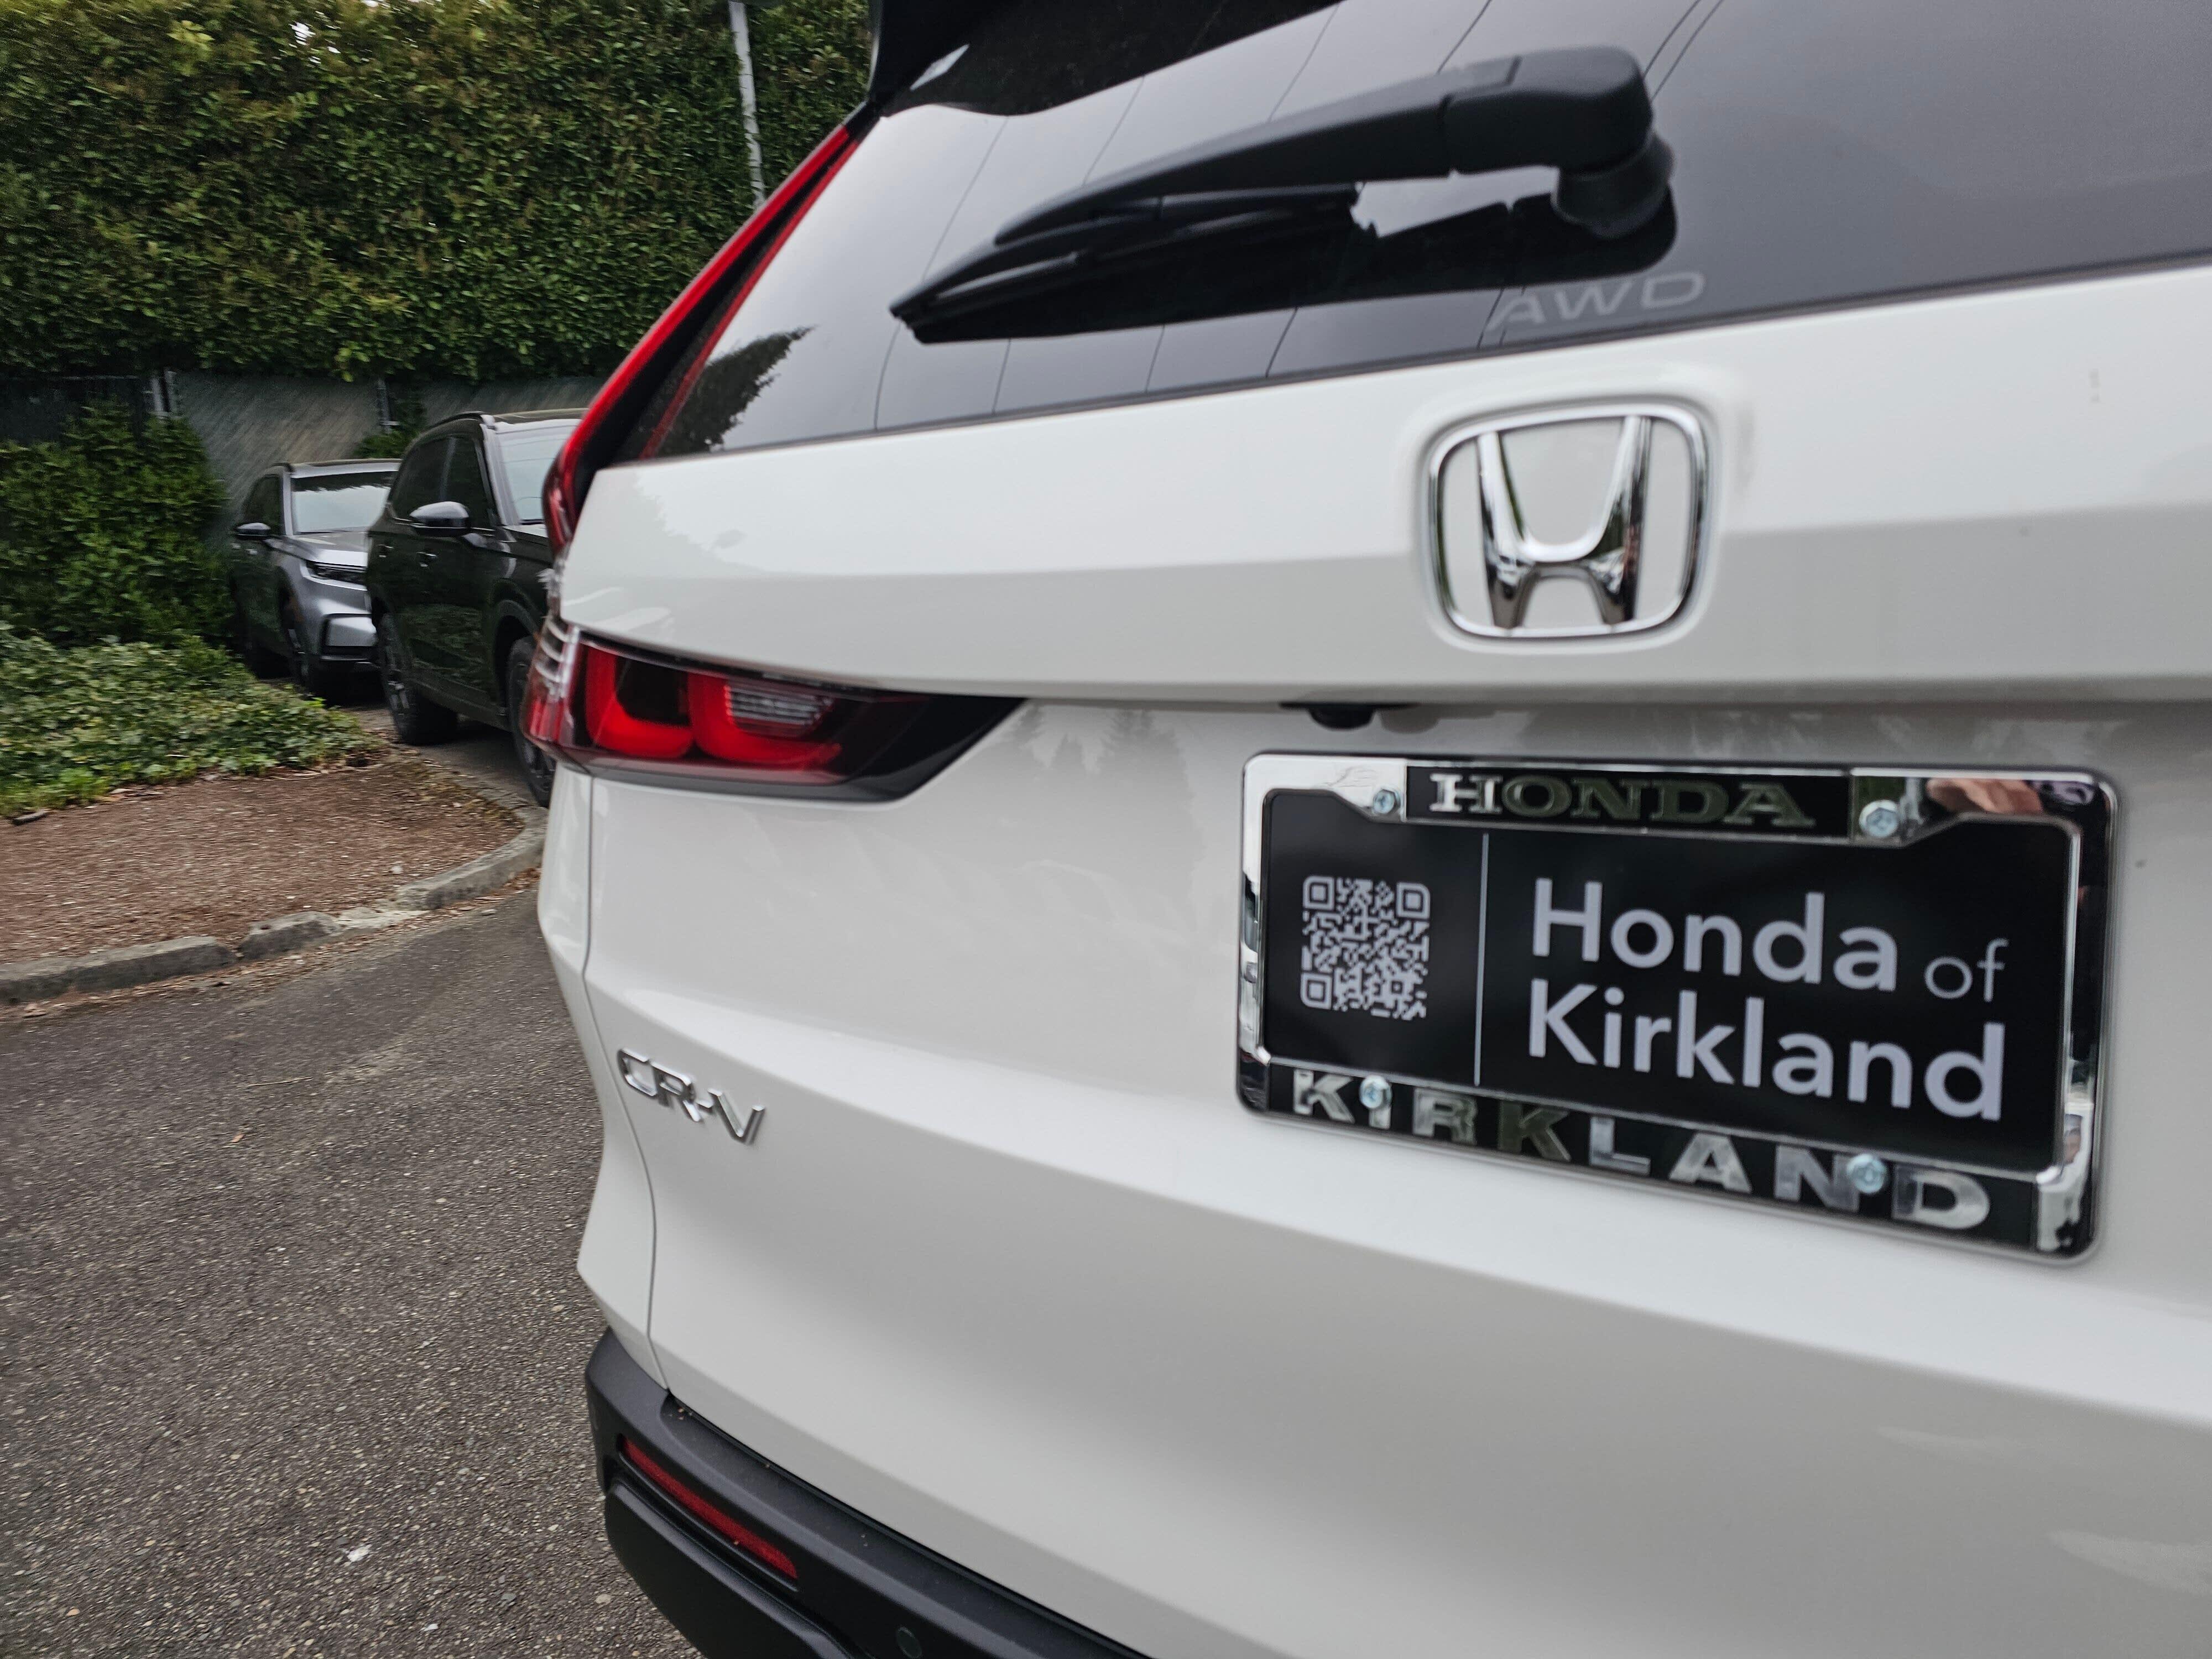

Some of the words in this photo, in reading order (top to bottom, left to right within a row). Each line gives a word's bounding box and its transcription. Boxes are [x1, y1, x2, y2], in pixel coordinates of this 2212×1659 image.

[1486, 272, 1705, 332] AWD
[1429, 774, 1816, 828] HONDA
[1532, 878, 1897, 992] Honda
[1924, 938, 2010, 1002] of
[617, 1048, 766, 1145] CR-V
[1528, 978, 2005, 1122] Kirkland
